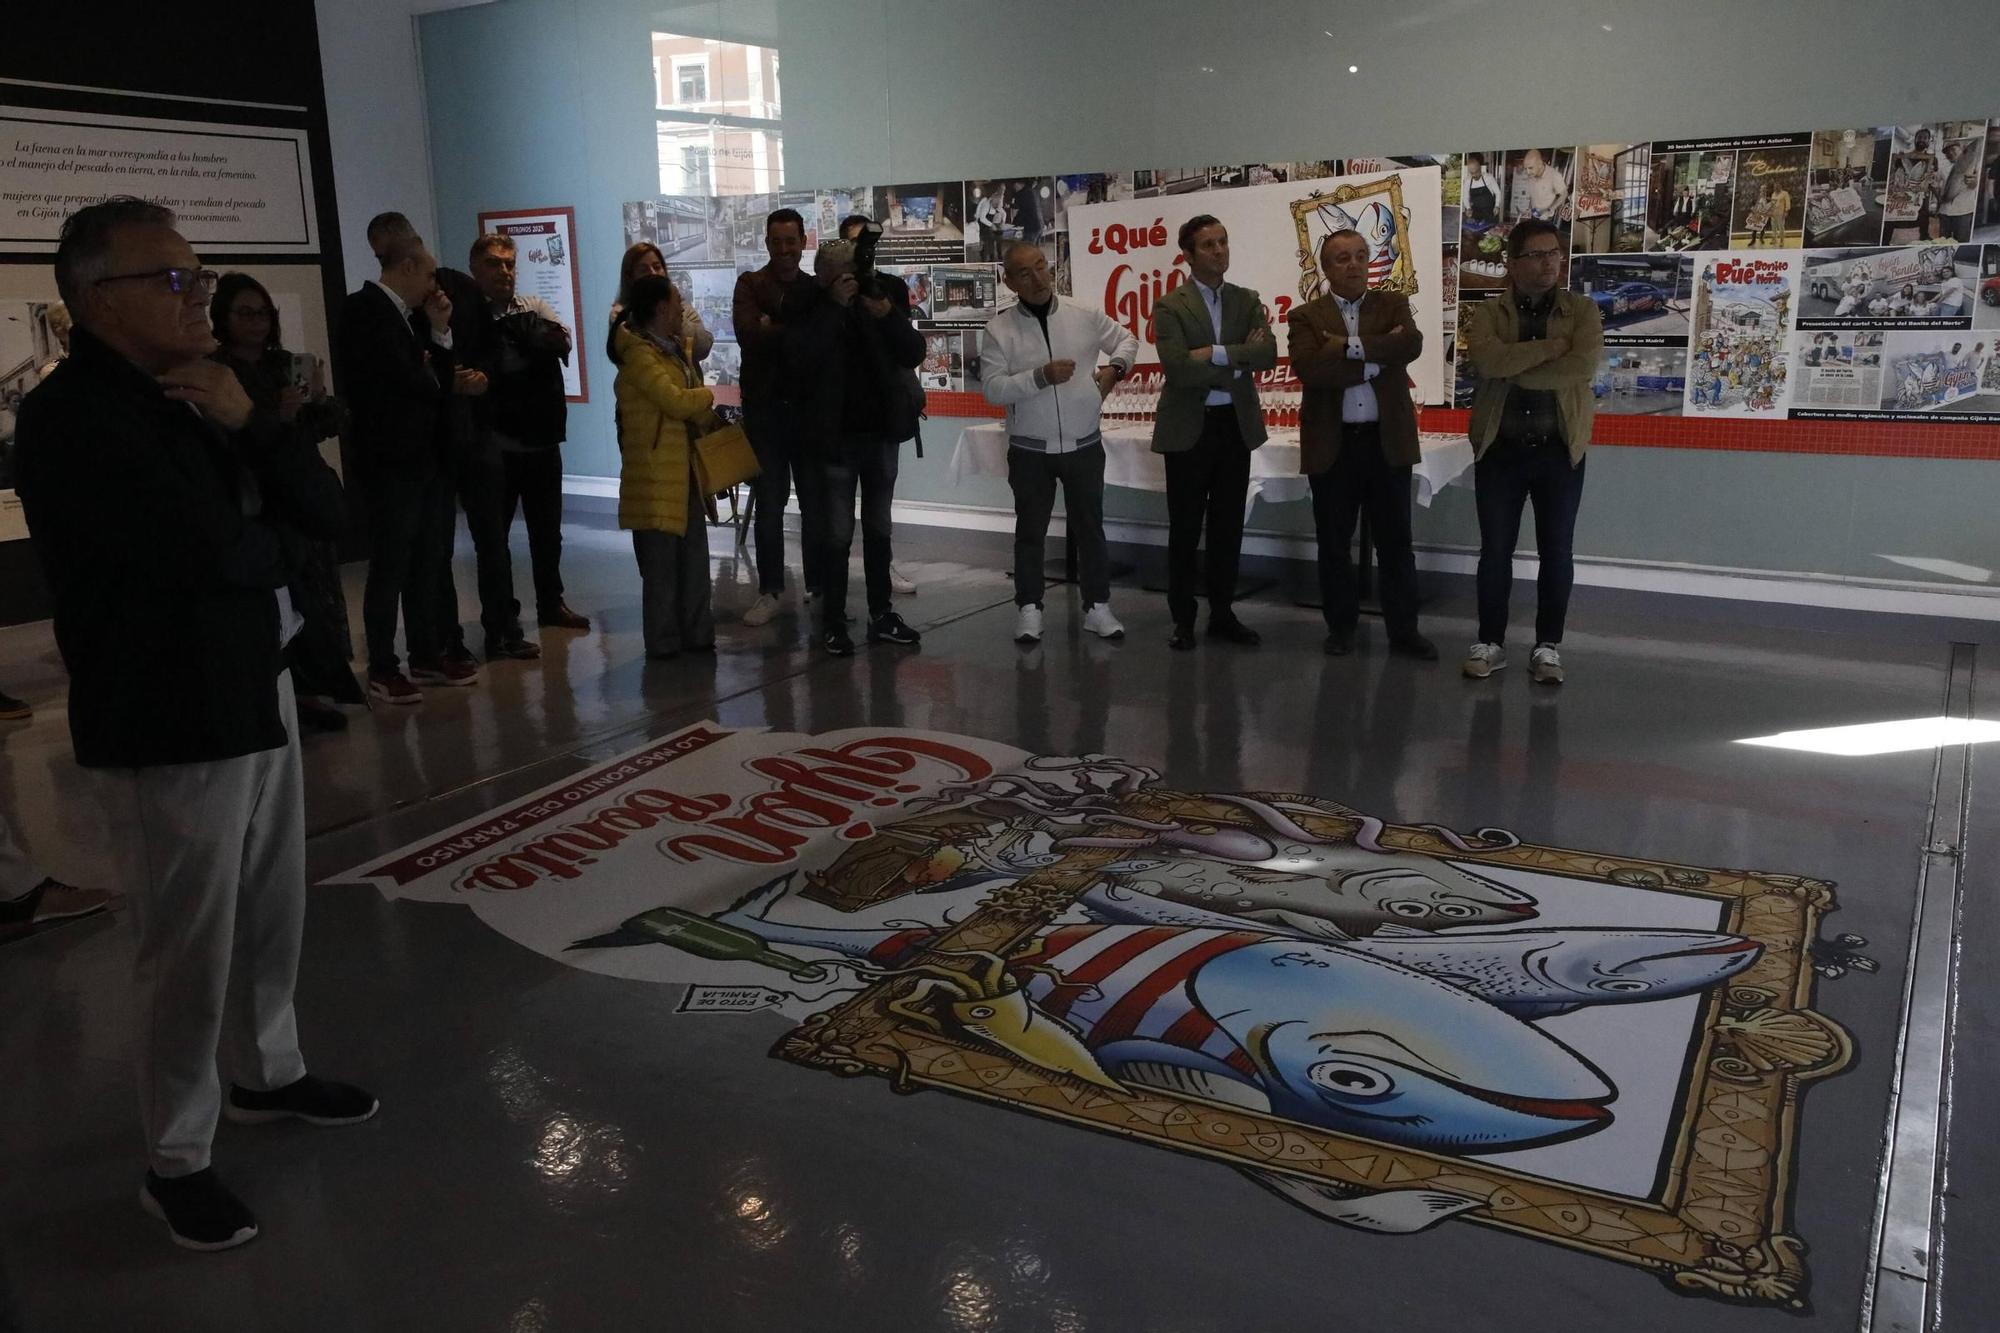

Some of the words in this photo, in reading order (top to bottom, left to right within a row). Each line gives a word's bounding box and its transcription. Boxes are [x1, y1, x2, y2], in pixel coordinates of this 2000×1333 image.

[15, 141, 29, 152] La
[31, 143, 60, 155] faena
[62, 147, 74, 155] en
[76, 145, 86, 156] la
[88, 149, 107, 157] mar
[109, 150, 169, 162] correspondía
[178, 152, 190, 161] los
[192, 153, 228, 164] hombres
[7, 157, 16, 168] el
[18, 159, 56, 173] manejo
[57, 160, 73, 171] del
[74, 162, 114, 174] pescado
[128, 166, 156, 176] tierra,
[170, 166, 179, 176] la
[202, 170, 218, 178] era
[216, 170, 257, 181] femenino.
[2, 190, 42, 204] mujeres
[44, 194, 63, 206] que
[181, 199, 187, 207] y
[189, 197, 223, 208] vendían
[224, 198, 232, 208] el
[232, 200, 266, 210] pescado
[17, 209, 29, 218] en
[32, 207, 60, 221] Gijón
[177, 213, 242, 223] reconocimiento.
[1088, 217, 1167, 254] ¿Qué
[1716, 263, 1755, 285] Rue
[1755, 260, 1789, 272] Bonito
[1105, 254, 1188, 345] Gijó
[1261, 365, 1298, 384] DEL
[676, 736, 706, 750] LO
[635, 746, 682, 768] MÁS
[563, 766, 638, 802] BONITO
[515, 798, 565, 819] DEL
[668, 737, 994, 866] Gijón
[416, 819, 520, 868] PARAISO
[461, 788, 733, 891] Bonito
[703, 991, 761, 999] FAMILIA
